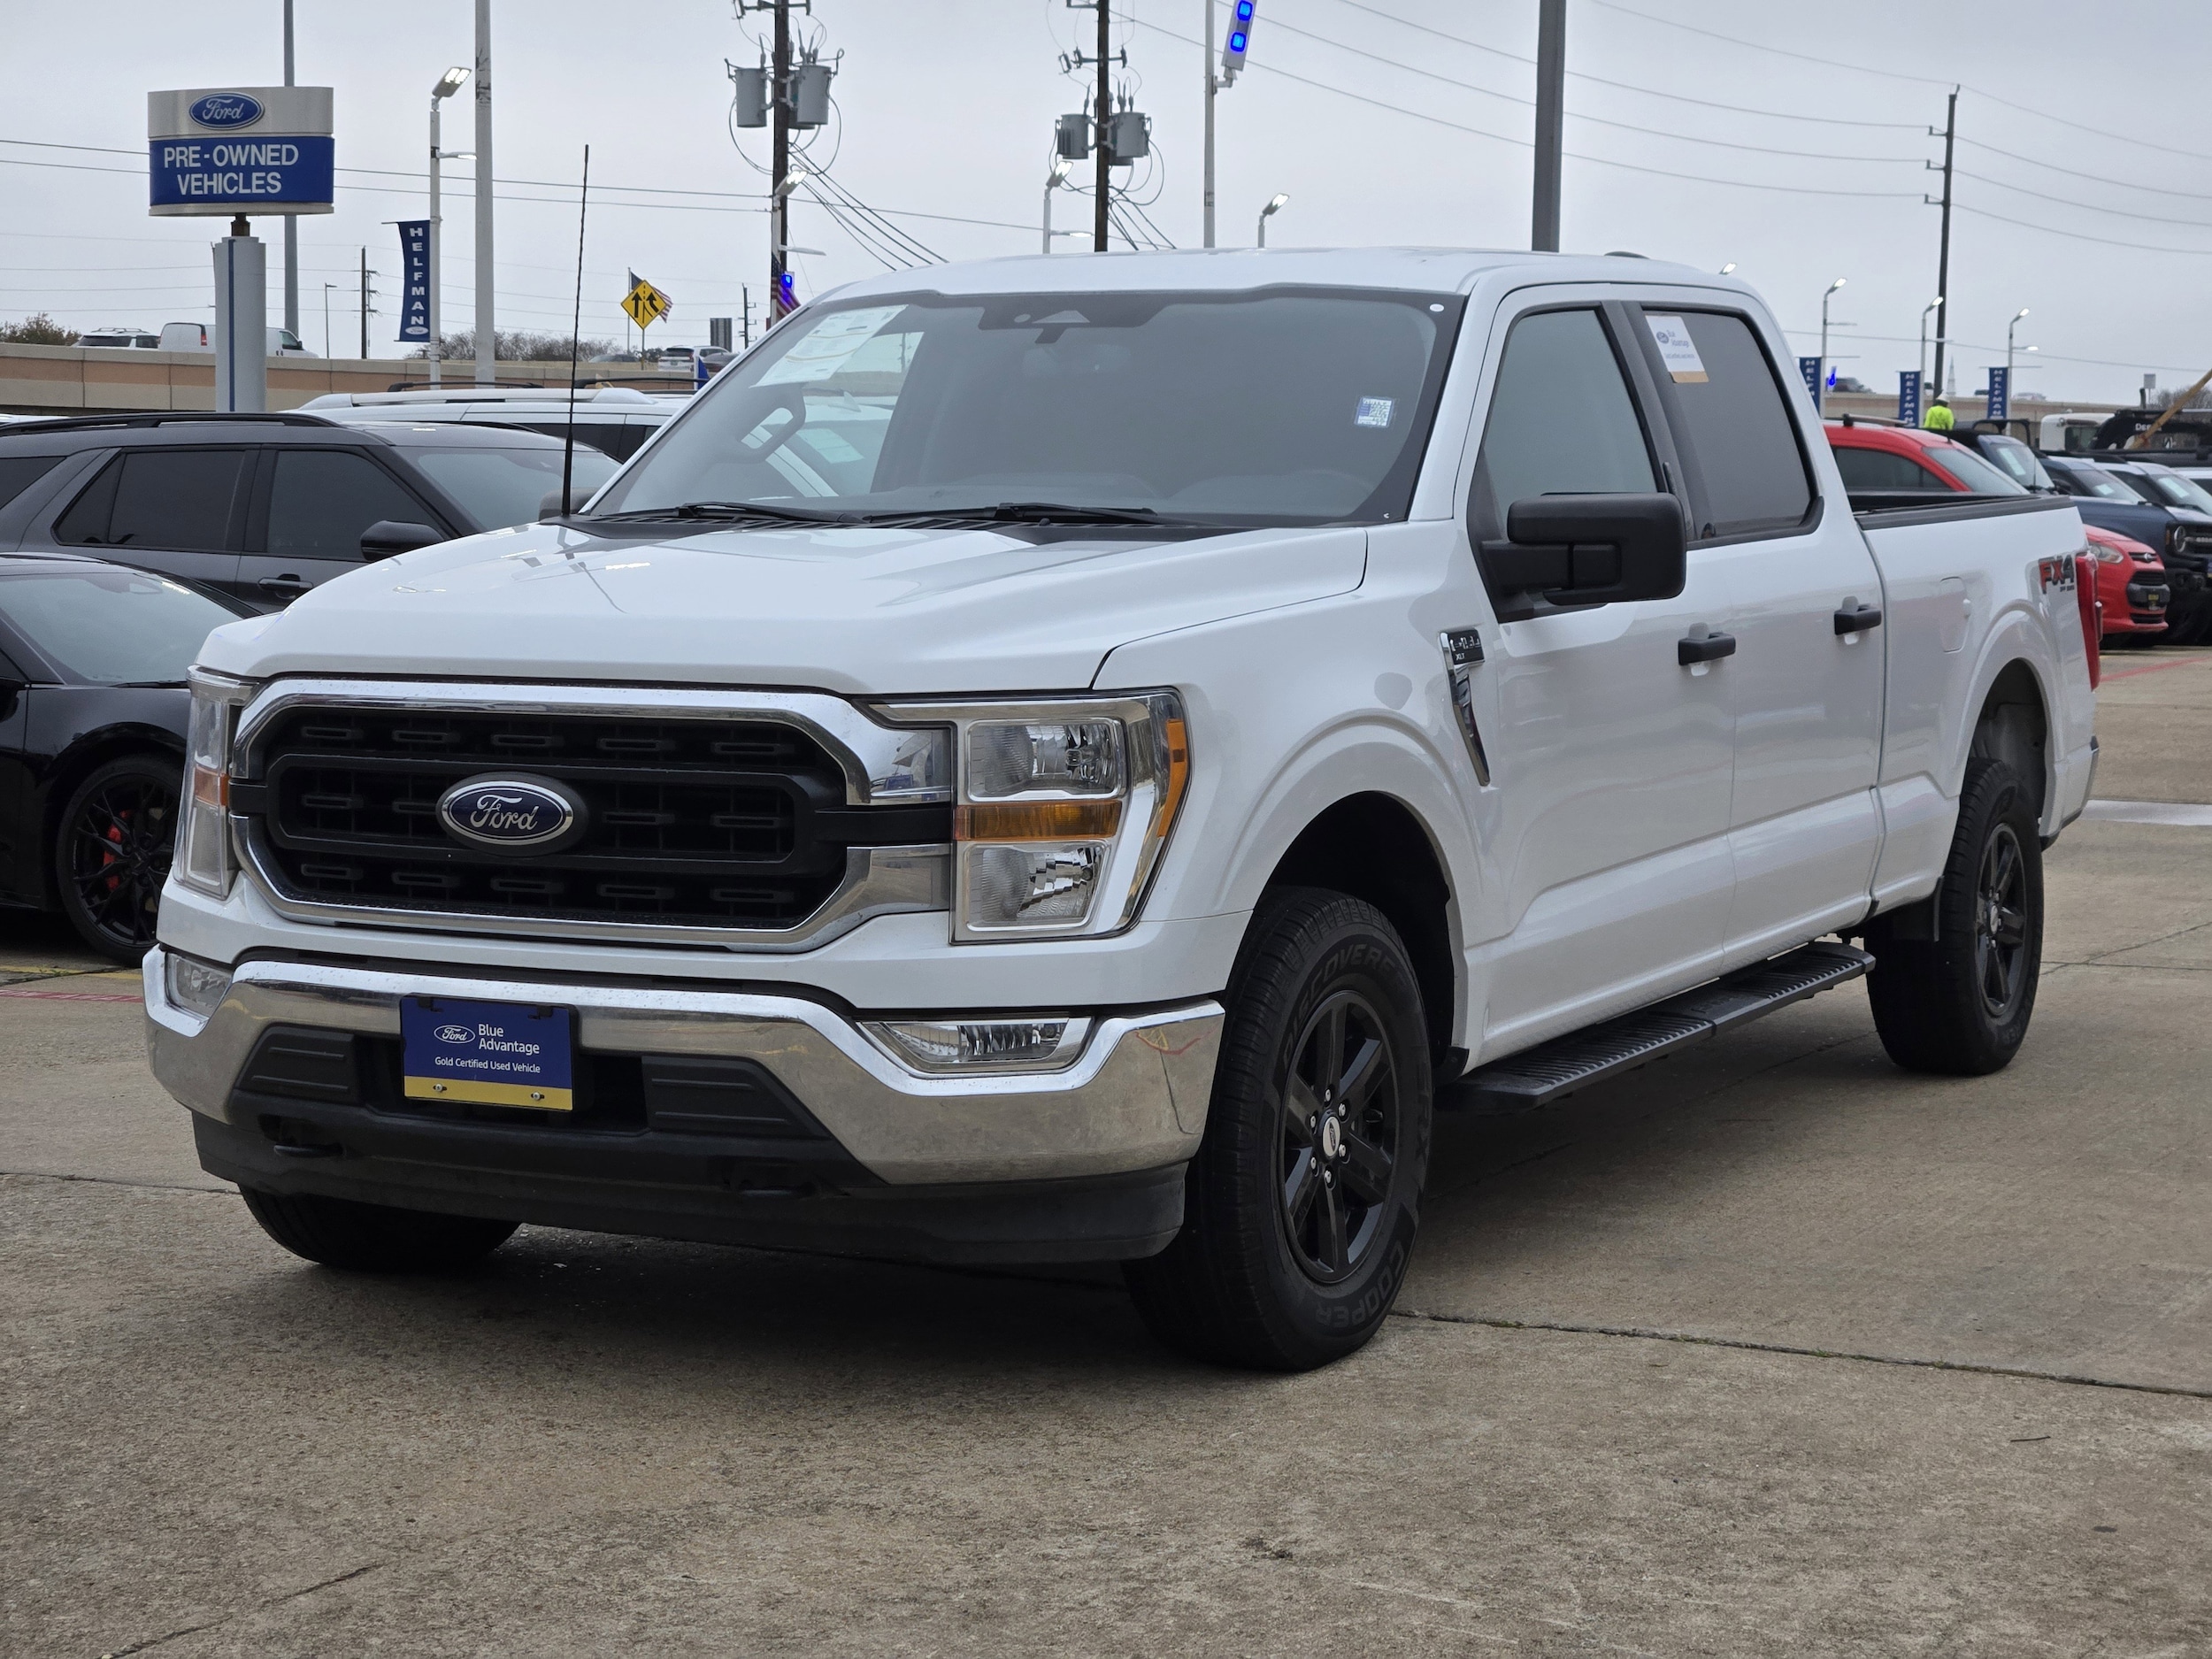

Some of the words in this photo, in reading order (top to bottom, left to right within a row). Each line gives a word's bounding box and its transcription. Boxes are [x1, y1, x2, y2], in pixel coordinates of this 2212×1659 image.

[203, 97, 244, 120] Ford
[164, 144, 299, 168] PRE-OWNED
[177, 173, 282, 196] VEHICLES
[410, 227, 426, 326] HELFMAN
[2038, 555, 2074, 595] FX4
[470, 795, 540, 830] Ford
[442, 1026, 468, 1041] Ford
[478, 1023, 504, 1037] Blue
[478, 1038, 540, 1056] Advantage
[434, 1056, 454, 1066] Gold
[455, 1057, 488, 1070] Certified
[490, 1061, 511, 1071] Used
[512, 1062, 541, 1073] Vehicle
[1315, 1240, 1406, 1329] COOPER
